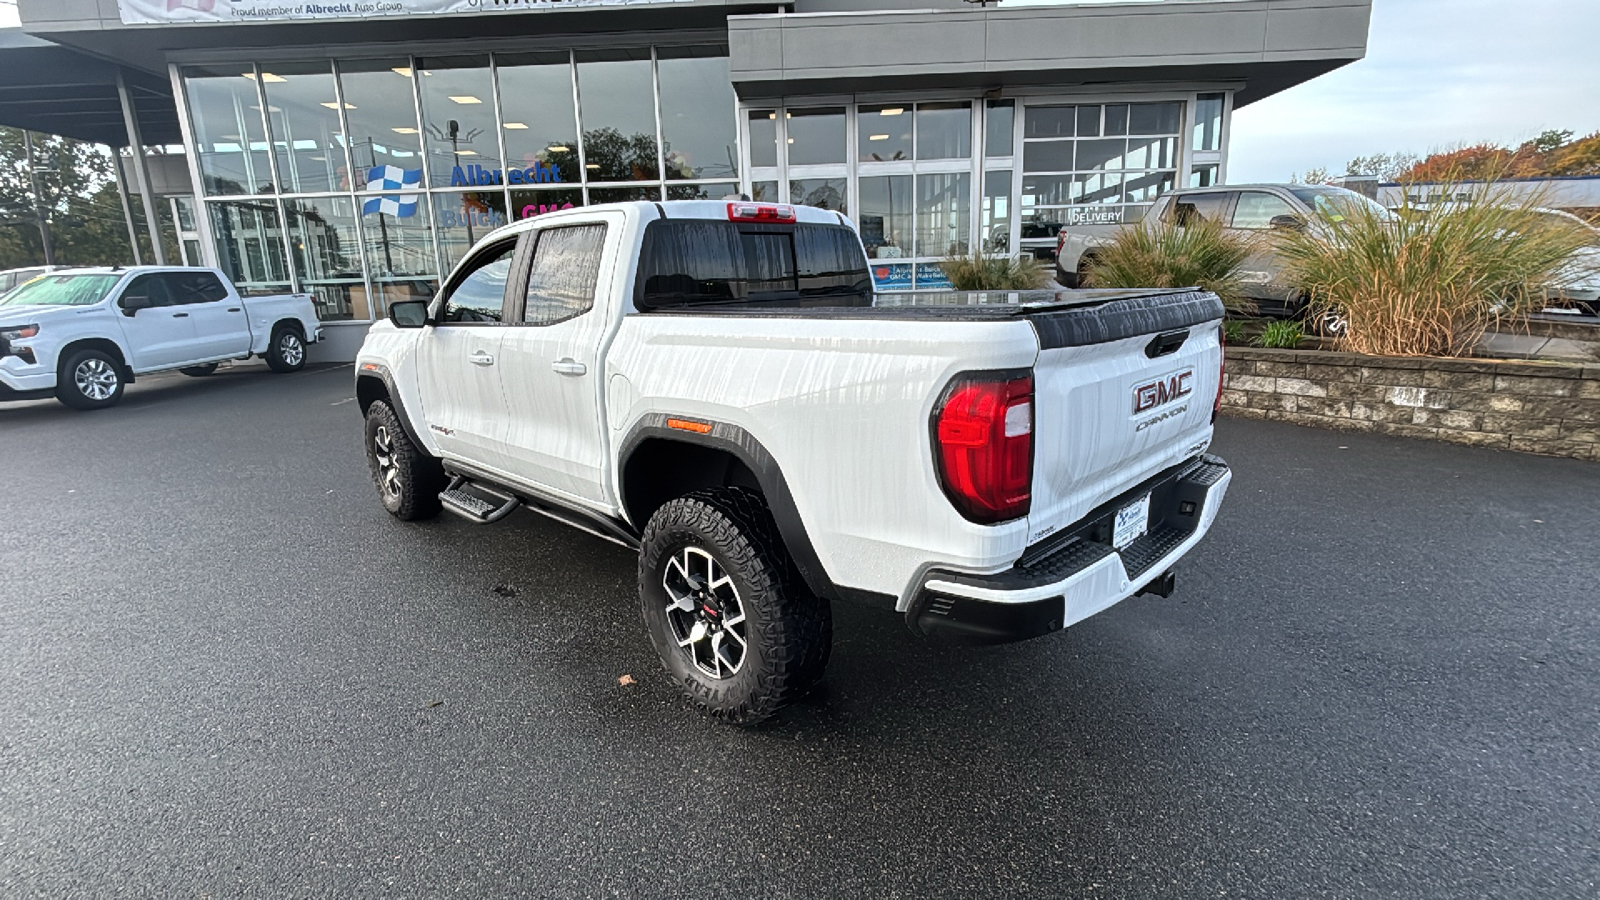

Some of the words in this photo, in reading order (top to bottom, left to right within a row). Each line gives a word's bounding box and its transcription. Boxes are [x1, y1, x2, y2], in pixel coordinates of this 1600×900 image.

[231, 7, 256, 16] Proud
[258, 6, 292, 16] member
[295, 5, 303, 14] of
[306, 4, 351, 14] Albrecht
[354, 3, 375, 12] Auto
[376, 2, 403, 12] Group
[450, 162, 561, 187] Albrecht
[442, 206, 502, 228] Buick
[1073, 211, 1121, 222] DELIVERY
[1133, 370, 1192, 414] GMC
